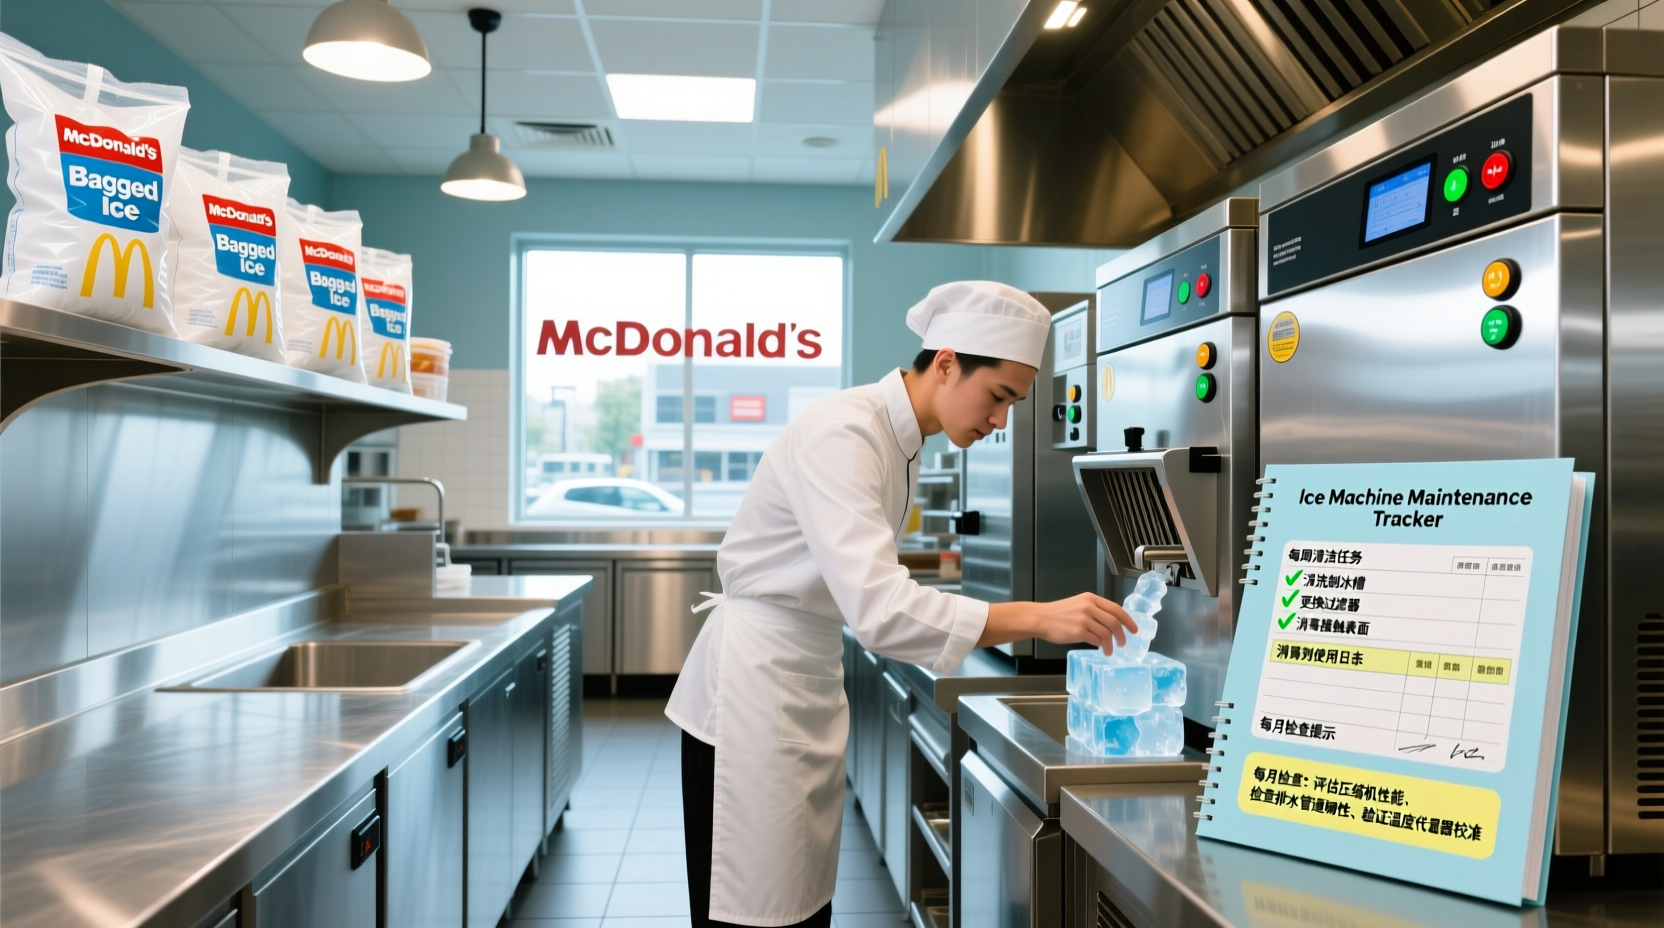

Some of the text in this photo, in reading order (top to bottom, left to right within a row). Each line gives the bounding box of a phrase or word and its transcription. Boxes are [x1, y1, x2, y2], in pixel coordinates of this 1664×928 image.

[63, 127, 157, 160] McDonald's
[69, 165, 158, 202] Bagged
[102, 196, 140, 221] Ice
[216, 233, 275, 260] Bagged
[240, 258, 265, 277] Ice
[536, 319, 823, 360] McDonald's
[1299, 488, 1533, 506] Ice Machine Maintenance
[1373, 510, 1444, 528] Tracker
